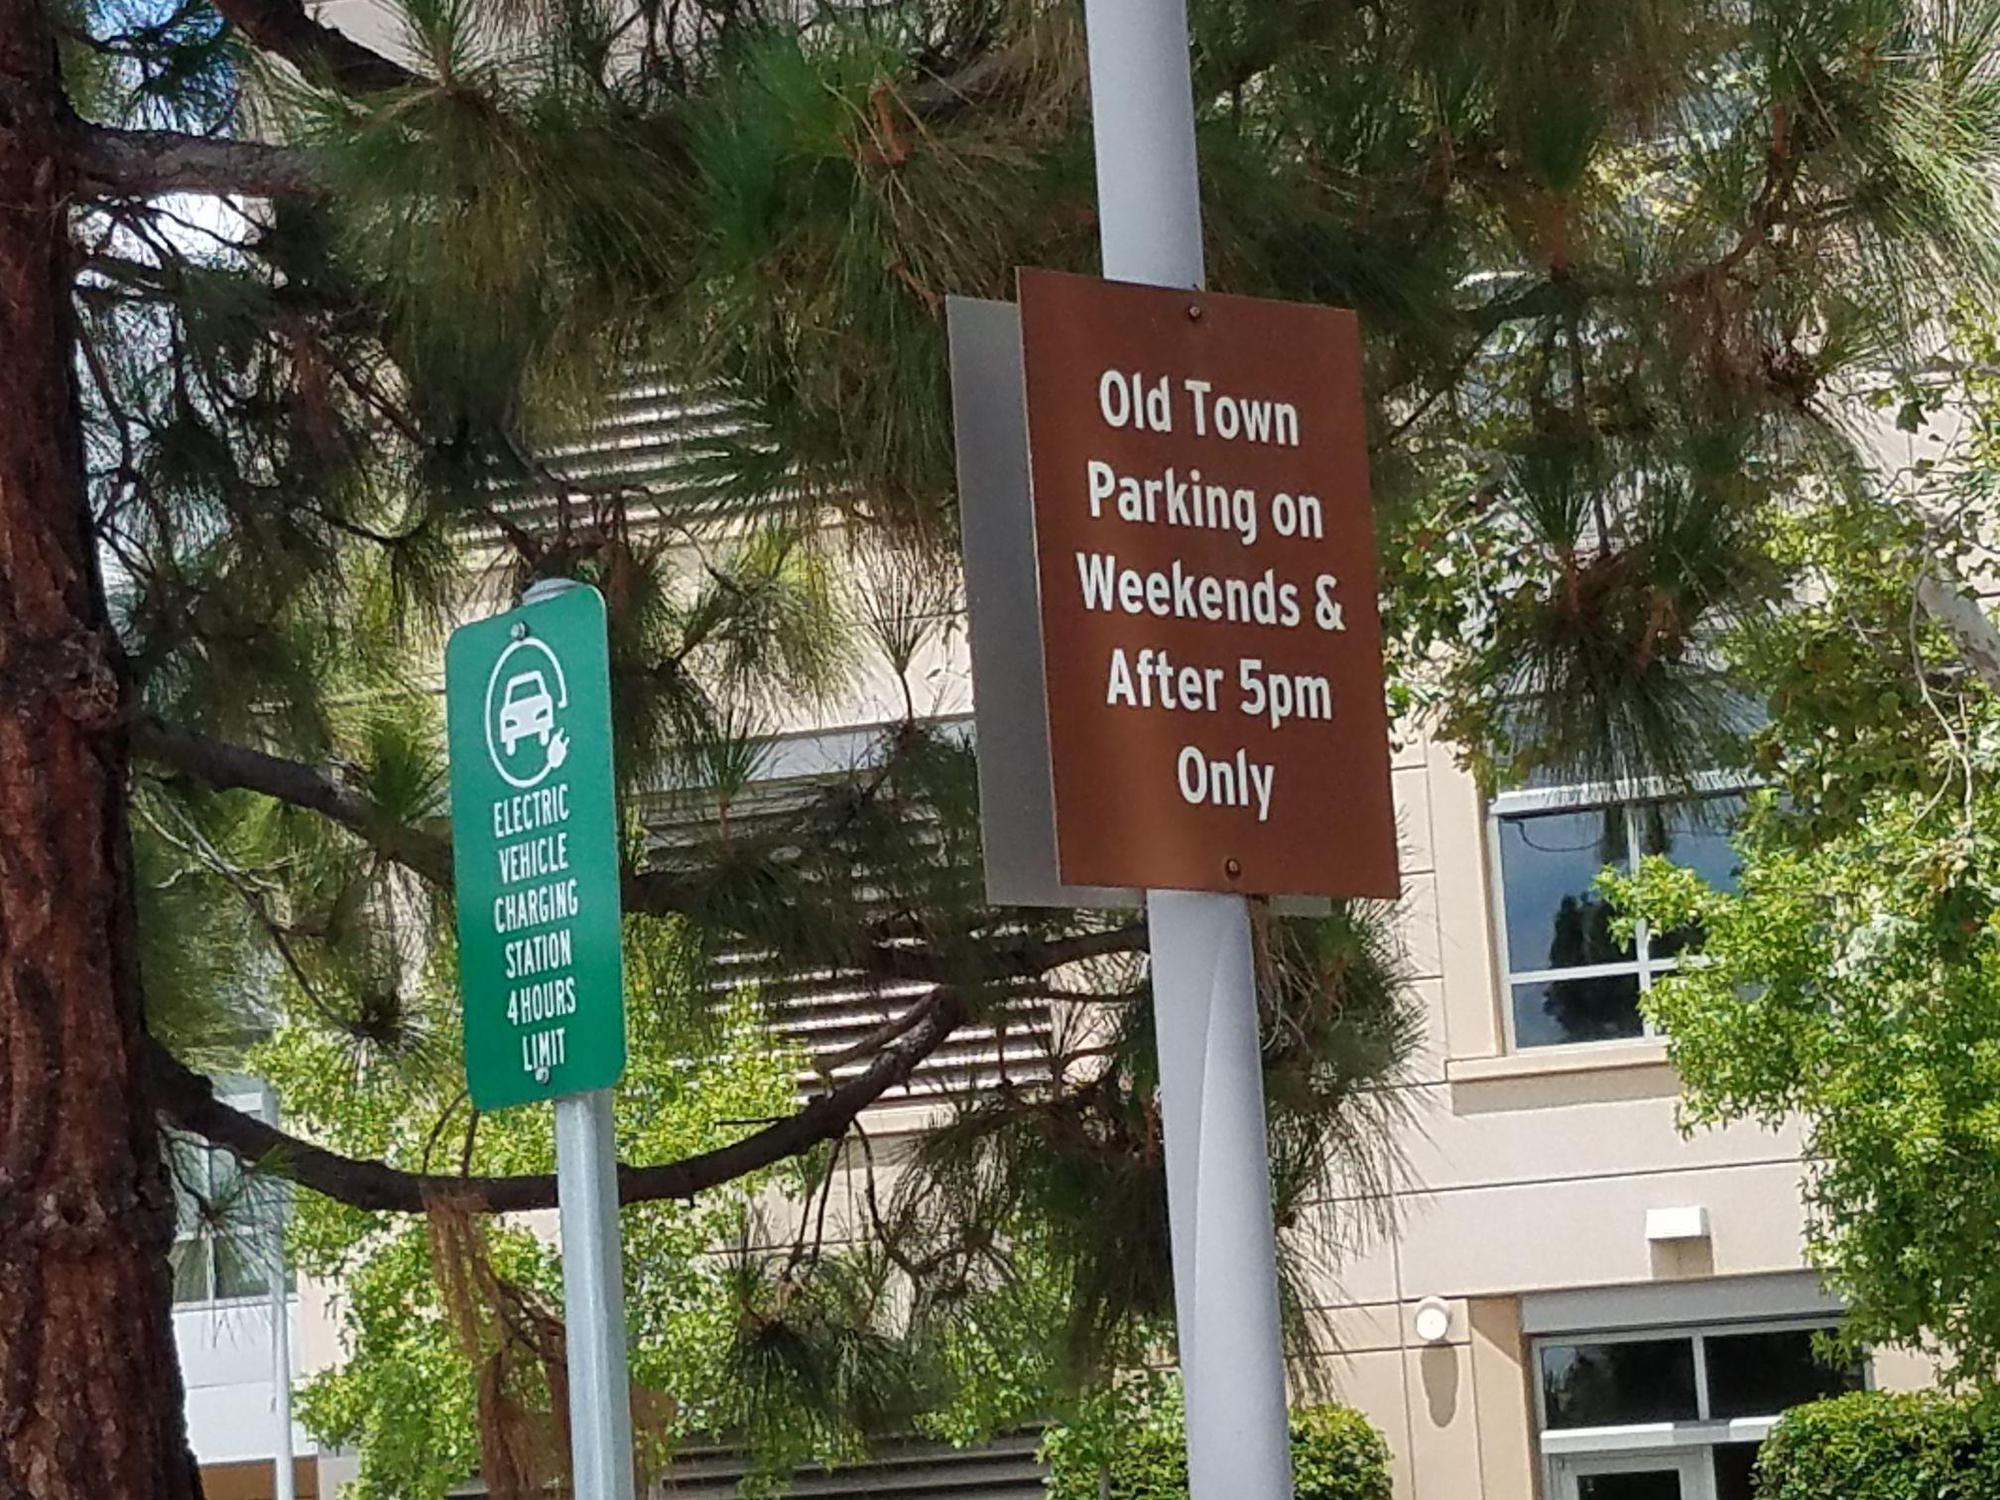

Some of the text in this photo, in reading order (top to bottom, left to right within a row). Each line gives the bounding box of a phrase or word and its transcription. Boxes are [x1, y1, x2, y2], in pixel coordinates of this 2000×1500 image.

[1099, 370, 1299, 446] Old Town
[1087, 460, 1324, 545] Parking on
[1076, 551, 1346, 630] Weekends &
[1107, 648, 1333, 729] After 5pm
[494, 783, 570, 838] ELECTRIC
[1177, 745, 1275, 821] Only
[498, 832, 569, 884] VEHICLE
[494, 878, 579, 933] CHARGING
[505, 929, 572, 979] STATION
[522, 1027, 565, 1072] LIMIT
